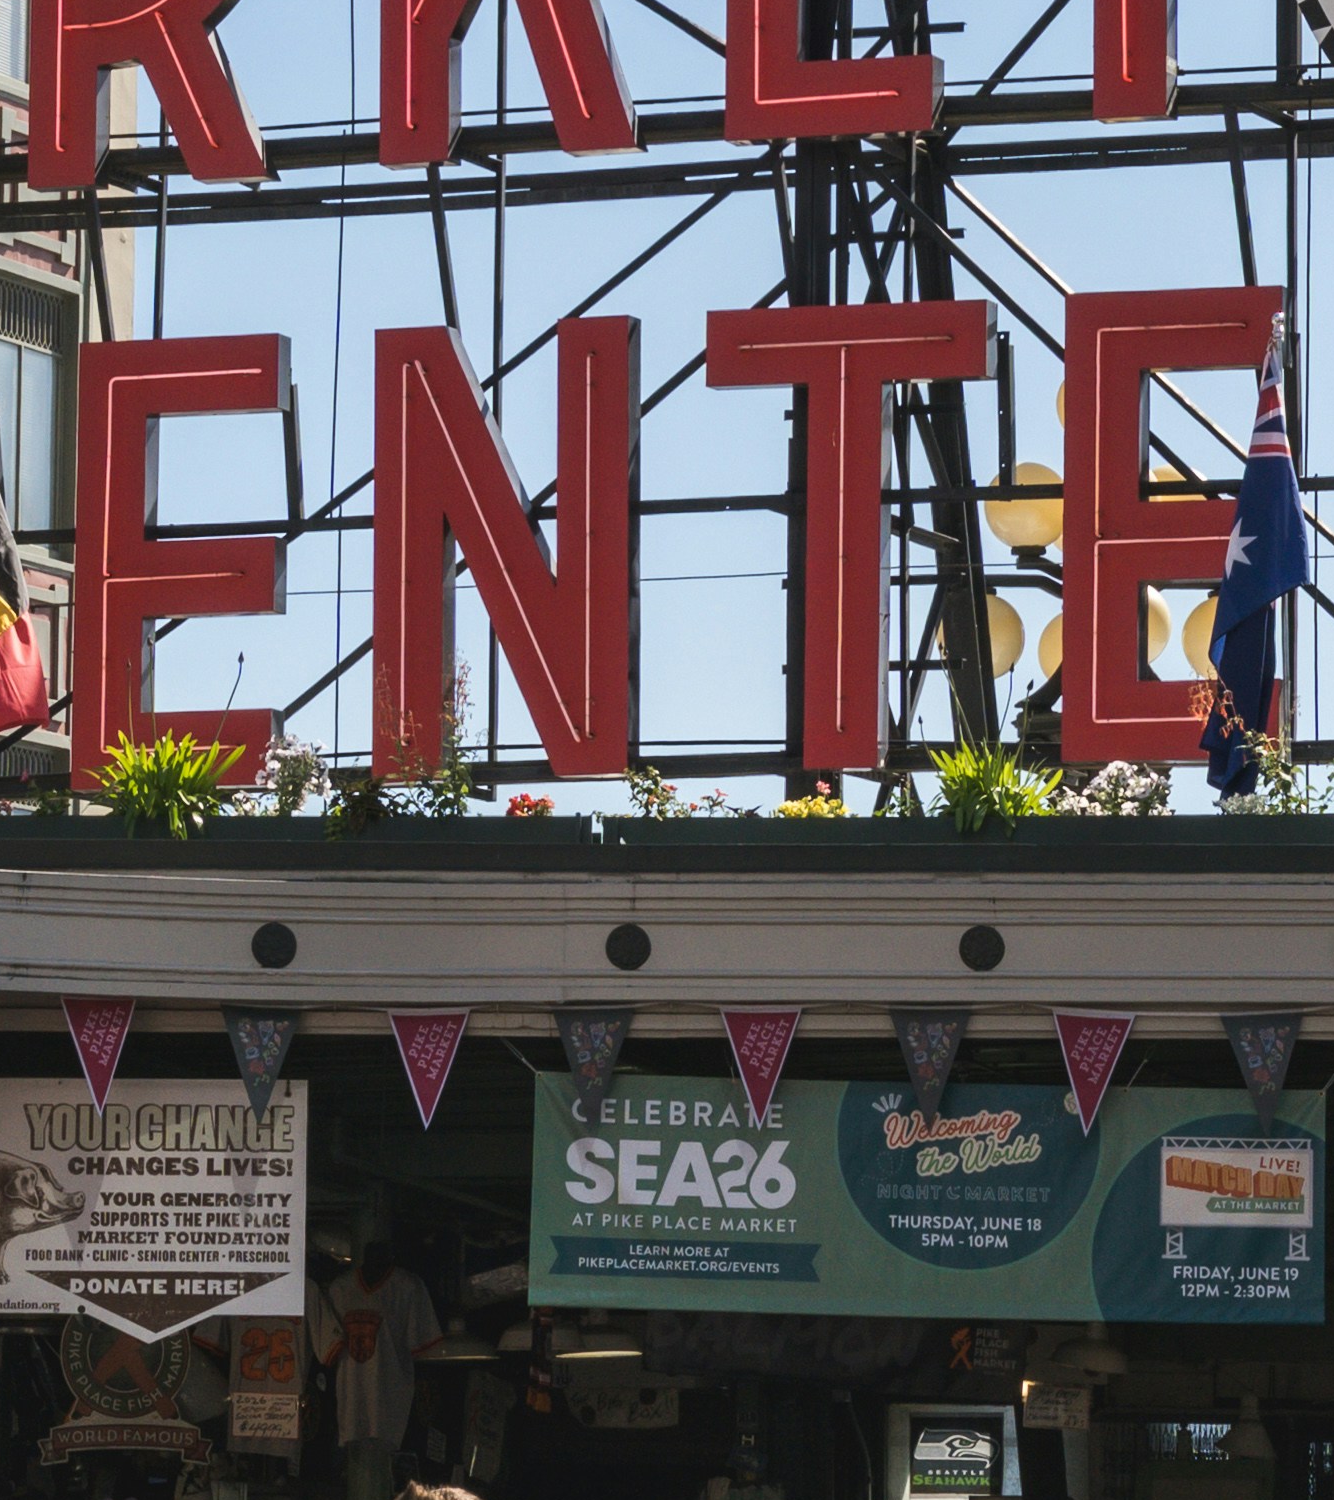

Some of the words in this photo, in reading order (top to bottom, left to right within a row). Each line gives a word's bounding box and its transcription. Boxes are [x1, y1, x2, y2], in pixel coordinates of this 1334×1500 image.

[80, 1010, 101, 1045] PIKE
[90, 1008, 113, 1055] PLACE
[99, 1006, 127, 1068] MARKET
[739, 1022, 762, 1058] PIKE
[749, 1021, 777, 1068] PLACE
[758, 1019, 791, 1082] MARKET
[572, 1098, 784, 1129] CELEBRATE
[24, 1104, 131, 1150] YOUR
[136, 1104, 295, 1152] CHANGE
[885, 1110, 1021, 1149] Welcoming
[918, 1148, 958, 1175] the
[961, 1134, 1041, 1172] World
[68, 1157, 199, 1176] CHANGES
[207, 1158, 293, 1176] LIVES!
[565, 1137, 796, 1209] SEA26
[1260, 1156, 1300, 1172] LIVE!
[1166, 1155, 1253, 1198] MATCH
[1253, 1170, 1305, 1198] DAY
[101, 1192, 155, 1206] YOUR
[160, 1193, 292, 1207] GENEROSITY
[877, 1184, 942, 1200] NIGHT
[965, 1186, 1050, 1202] MARKET
[1214, 1201, 1227, 1209] AT
[1230, 1201, 1251, 1209] THE
[1255, 1201, 1300, 1210] MARKET
[91, 1212, 169, 1227] SUPPORTS
[174, 1213, 202, 1227] THE
[206, 1213, 239, 1227] PIKE
[244, 1213, 290, 1228] PLACE
[572, 1213, 594, 1227] AT
[602, 1214, 644, 1228] PIKE
[652, 1215, 712, 1230] PLACE
[720, 1218, 797, 1232] MARKET
[889, 1215, 977, 1232] THURSDAY,
[981, 1217, 1023, 1231] JUNE
[1027, 1218, 1041, 1231] 18
[78, 1231, 159, 1244] MARKET
[165, 1232, 290, 1245] FOUNDATION
[922, 1234, 954, 1246] 5PM
[969, 1235, 1008, 1247] 10PM
[25, 1250, 52, 1260] FOOD
[55, 1250, 83, 1261] BANK
[92, 1250, 128, 1262] CLINIC
[137, 1251, 176, 1262] SENIOR
[179, 1251, 219, 1262] CENTER
[228, 1252, 290, 1263] PRESCHOOL
[630, 1245, 670, 1256] LEARN
[673, 1246, 711, 1257] MORE
[713, 1248, 730, 1257] AT
[578, 1257, 780, 1273] PIKEPLACEMARKET.ORG/EVENTS
[1173, 1266, 1234, 1282] FRIDAY,
[1238, 1268, 1279, 1280] JUNE
[1284, 1268, 1298, 1280] 19
[69, 1279, 167, 1294] DONATE
[174, 1279, 245, 1295] HERE!
[1181, 1284, 1219, 1297] 12PM
[1234, 1285, 1290, 1298] 2:30PM
[70, 1330, 83, 1370] PIKE
[77, 1376, 121, 1410] PLACE
[127, 1389, 163, 1411] FISH
[58, 1430, 117, 1444] WORLD
[123, 1429, 194, 1446] FAMOUS
[912, 1474, 991, 1487] SEAHAWK
